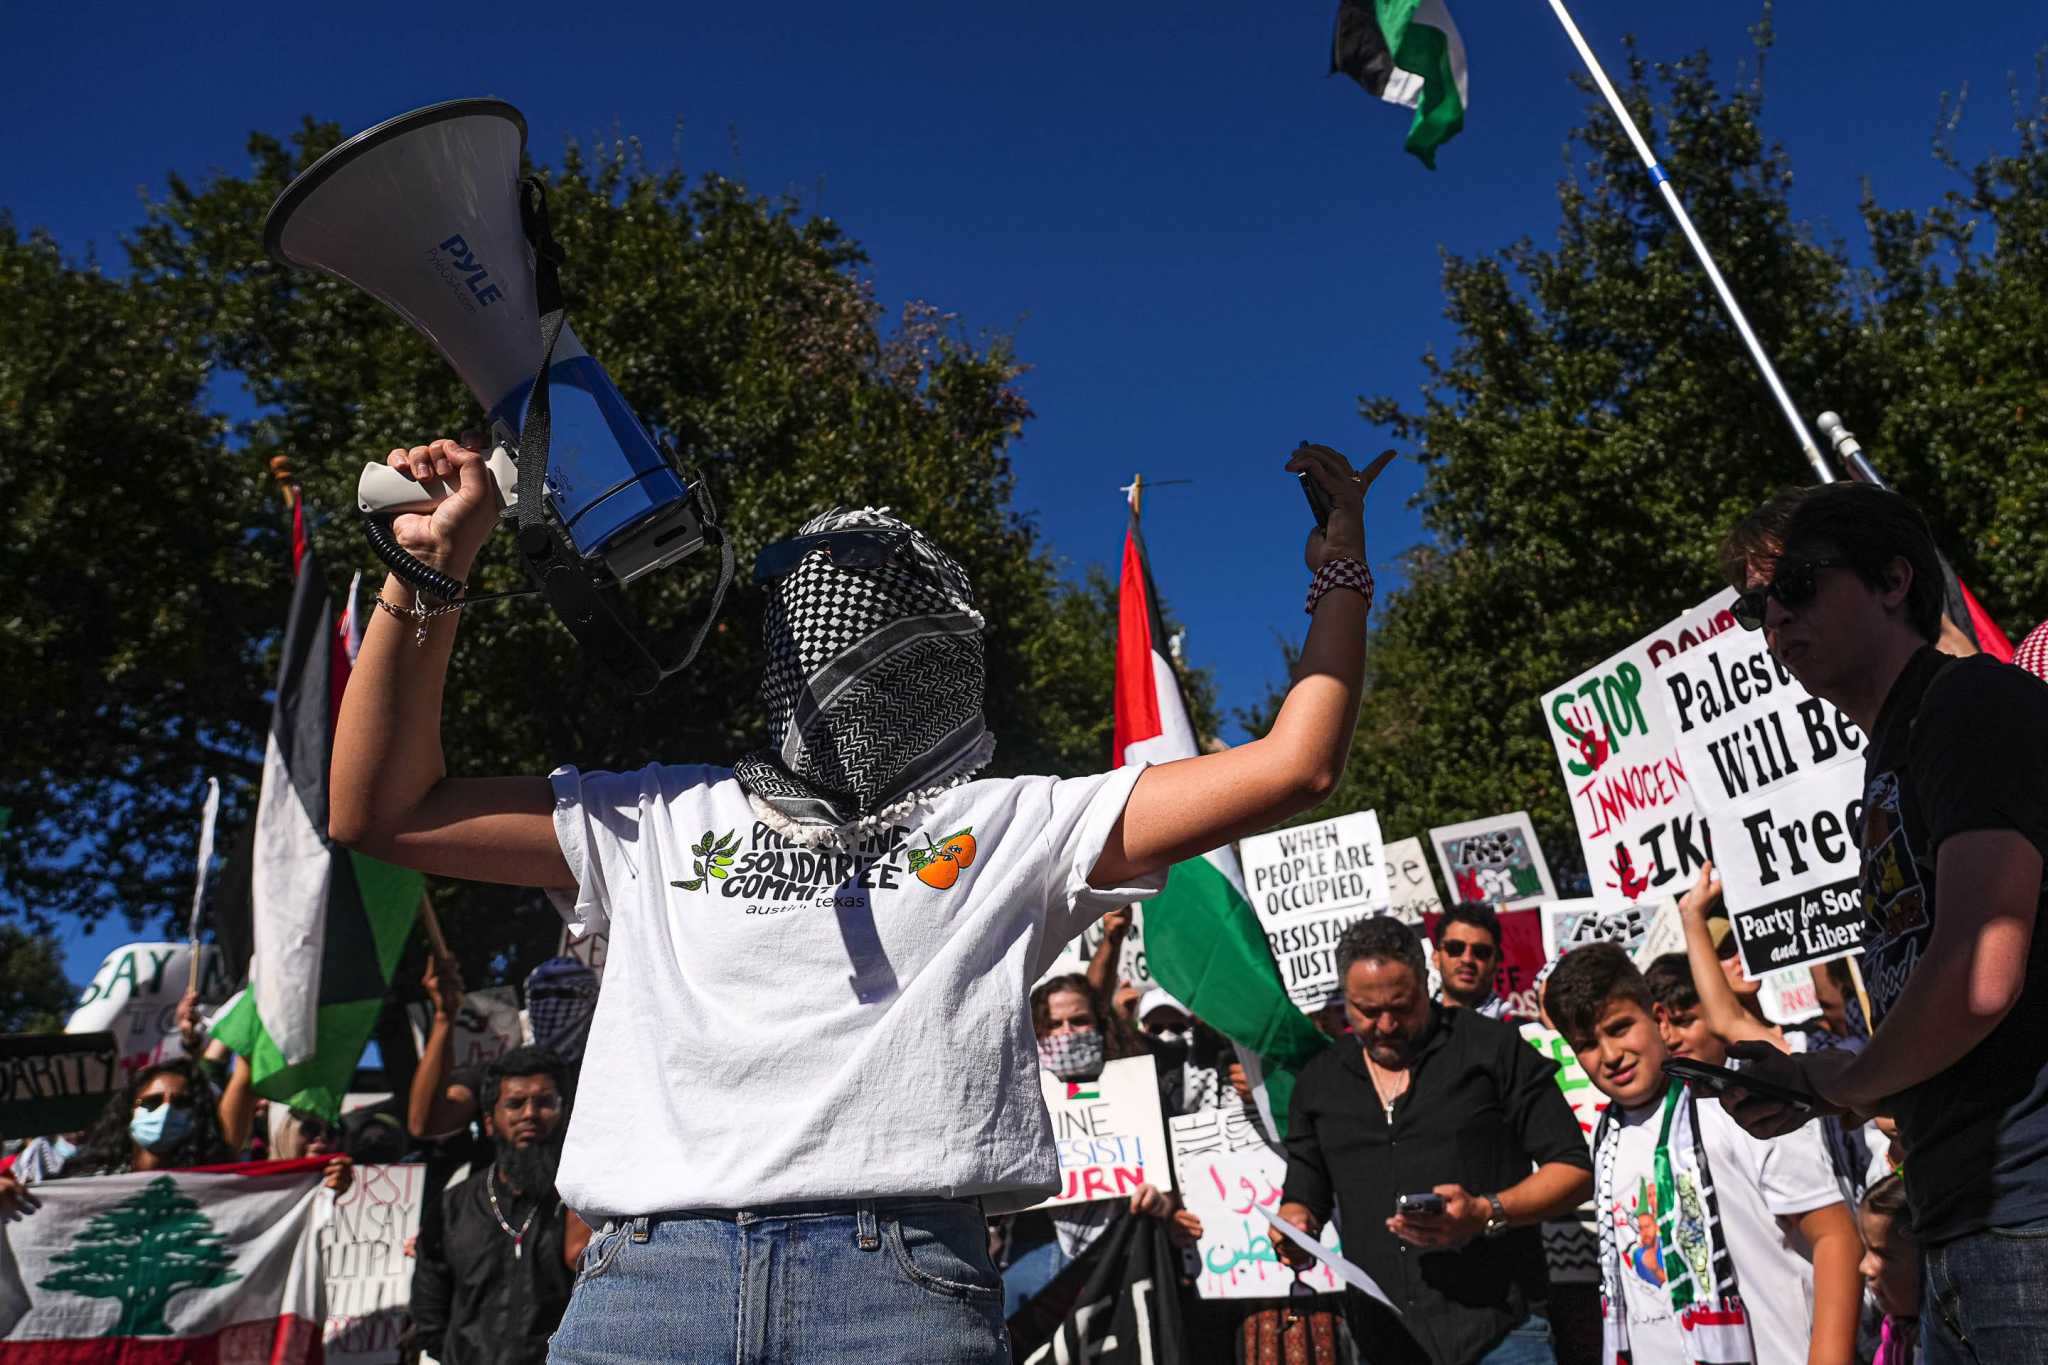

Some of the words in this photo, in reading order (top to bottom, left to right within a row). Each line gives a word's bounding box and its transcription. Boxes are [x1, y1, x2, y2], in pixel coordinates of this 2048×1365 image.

[440, 234, 502, 306] PYLE
[1552, 661, 1648, 776] STOP
[1707, 711, 1798, 799] Will
[1796, 698, 1860, 764] Be
[1577, 748, 1688, 839] INNOCEN
[1278, 823, 1339, 858] WHEN
[721, 863, 902, 901] COMMIEE
[1255, 853, 1328, 891] PEOPLE
[1335, 843, 1374, 873] ARE
[815, 895, 865, 908] texas
[1267, 873, 1371, 915] OCCUPIED,
[1267, 913, 1369, 955] RESISTA
[1739, 908, 1795, 942] Party
[1800, 895, 1821, 928] for
[1770, 934, 1801, 962] and
[1801, 920, 1865, 954] Liber
